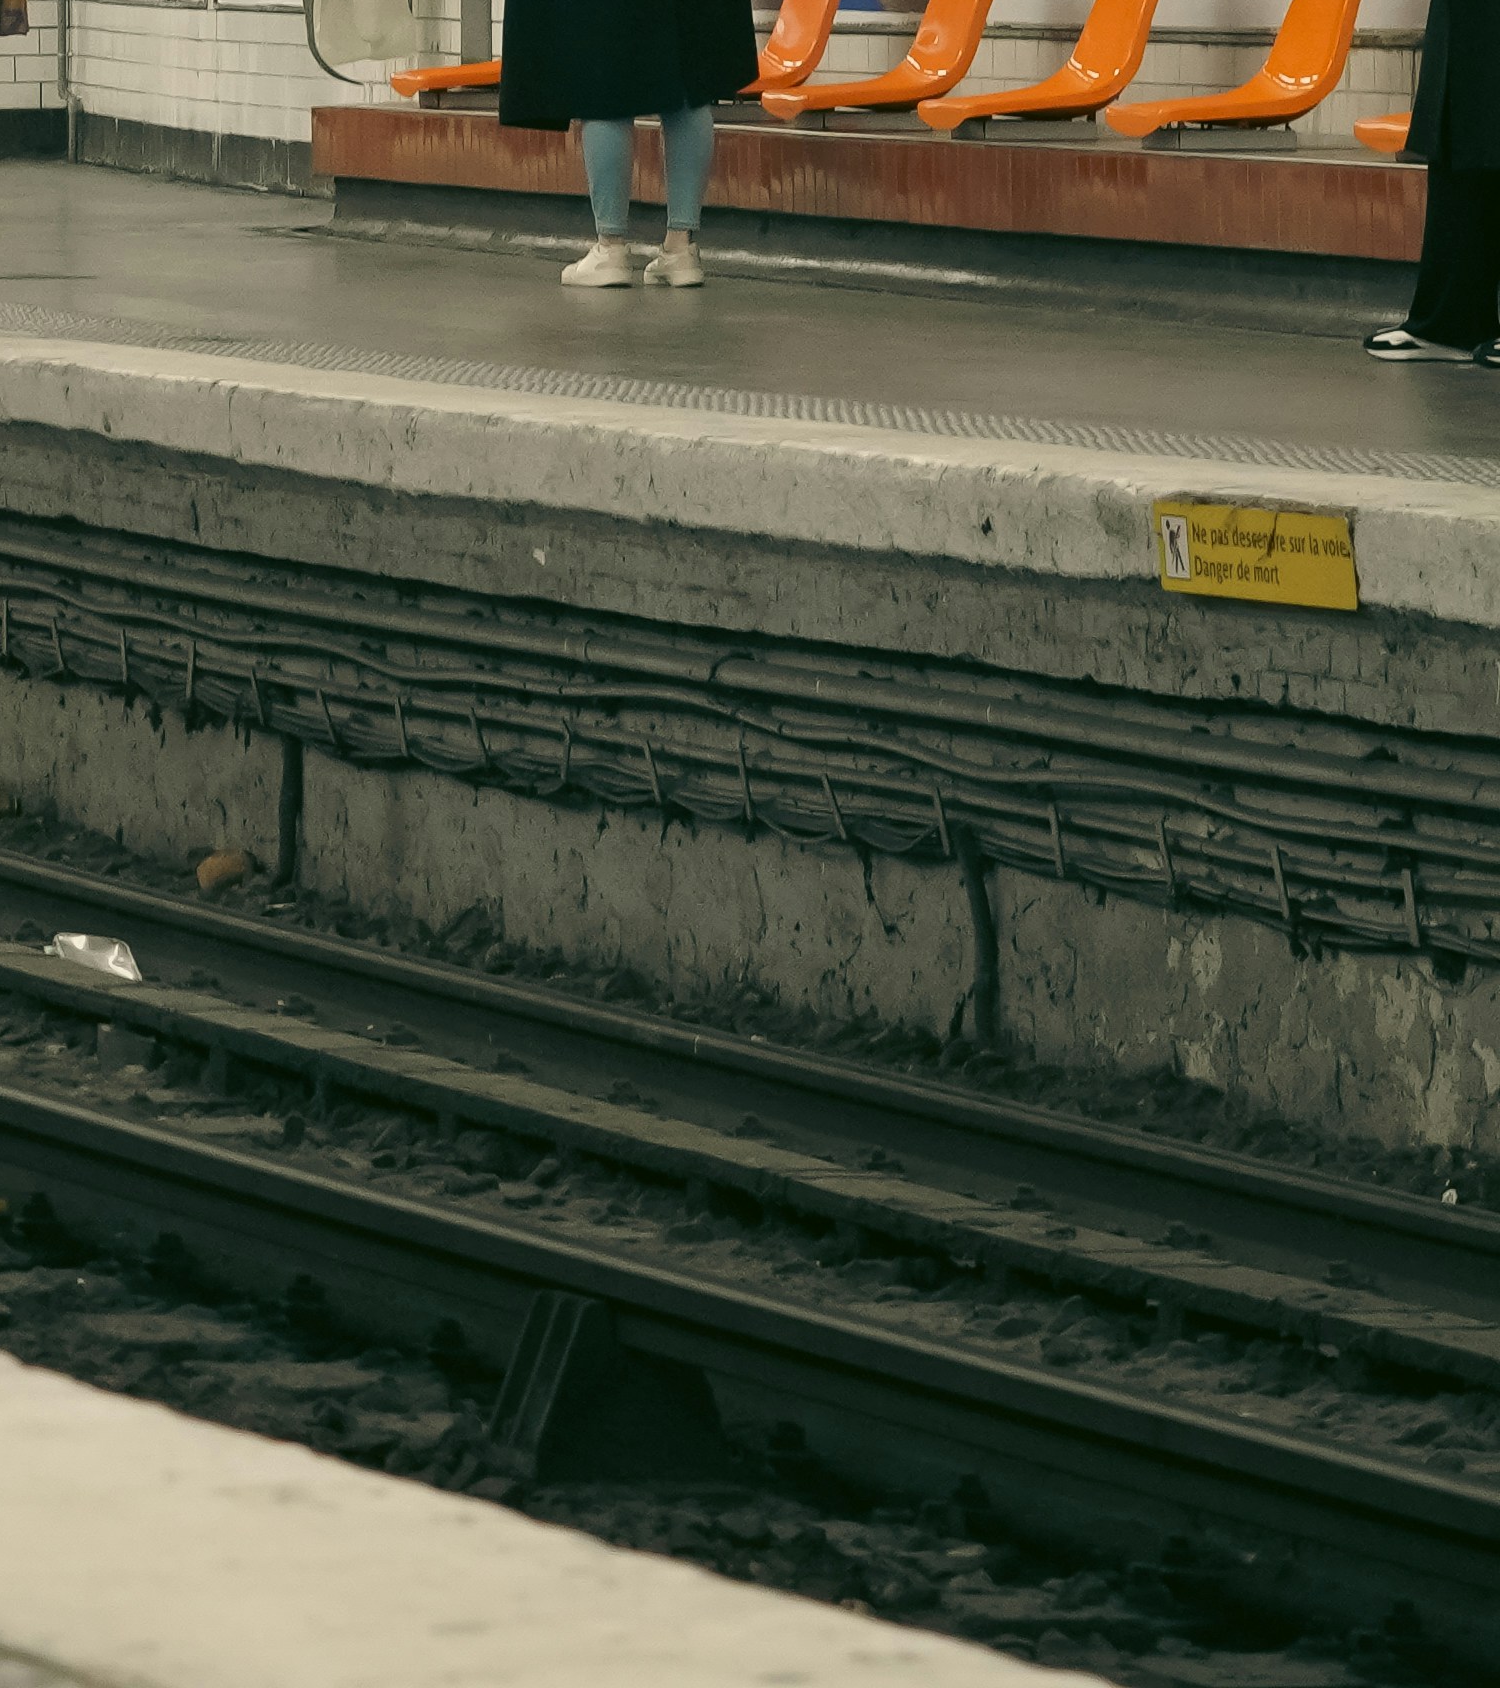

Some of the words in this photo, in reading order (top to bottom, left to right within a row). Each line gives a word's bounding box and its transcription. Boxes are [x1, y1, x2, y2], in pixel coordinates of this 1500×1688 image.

[1192, 522, 1208, 545] Ne
[1211, 527, 1229, 549] pas
[1289, 534, 1306, 554] sur
[1309, 533, 1319, 555] la
[1194, 555, 1233, 585] Danger
[1237, 559, 1250, 582] de
[1254, 565, 1280, 585] mort
